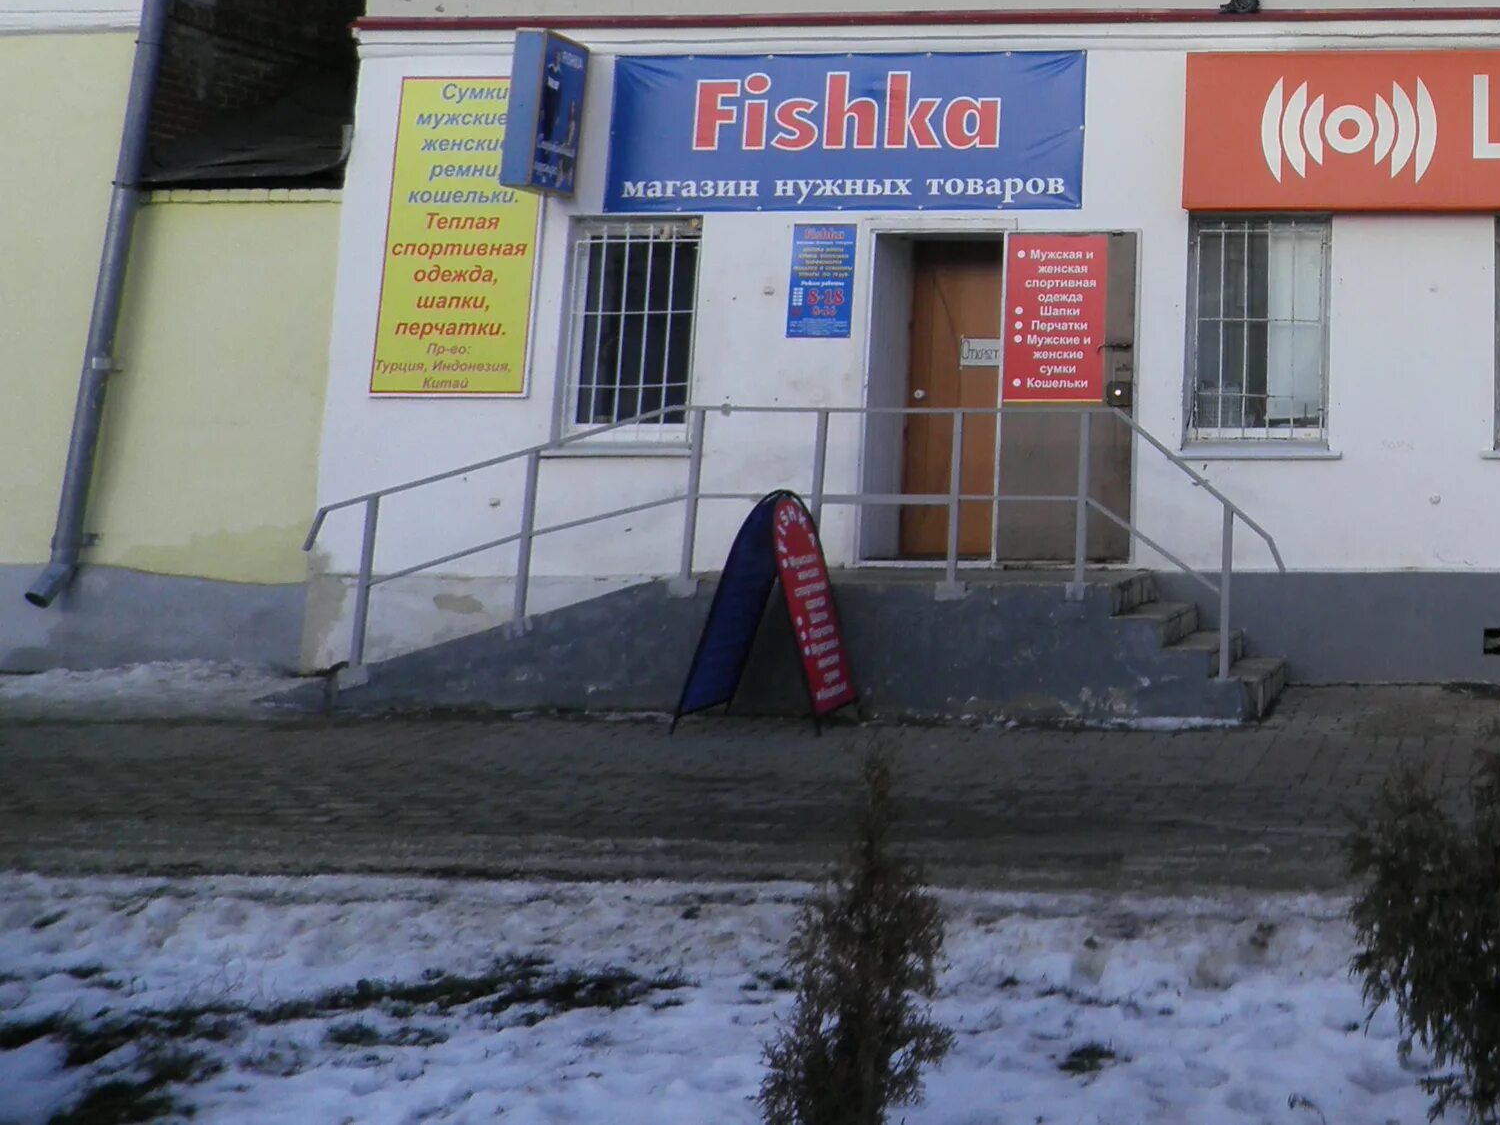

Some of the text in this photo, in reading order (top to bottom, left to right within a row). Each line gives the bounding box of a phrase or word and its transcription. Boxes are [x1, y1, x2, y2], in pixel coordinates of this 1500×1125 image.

[442, 83, 509, 104] Сумки
[692, 71, 1001, 151] Fishka
[621, 175, 1065, 204] магазин нужных товаров
[408, 190, 518, 204] кошельки.
[426, 213, 500, 230] Теплая
[392, 243, 527, 259] спортивная
[1030, 249, 1094, 263] Мужская и
[413, 265, 498, 285] одежда,
[1038, 265, 1088, 274] женская
[1025, 279, 1097, 289] спортивная
[416, 295, 490, 311] шапки,
[1037, 293, 1083, 303] одежда
[1040, 306, 1080, 316] Шапки
[394, 322, 506, 339] перчатки.
[1031, 320, 1088, 332] Перчатки
[1027, 335, 1080, 347] Мужские
[426, 343, 471, 356] Пр-во:
[1033, 350, 1084, 359] женские
[376, 359, 427, 374] Турция,
[1040, 365, 1076, 376] сумки
[422, 377, 469, 389] Китай
[1026, 378, 1088, 388] Кошельки
